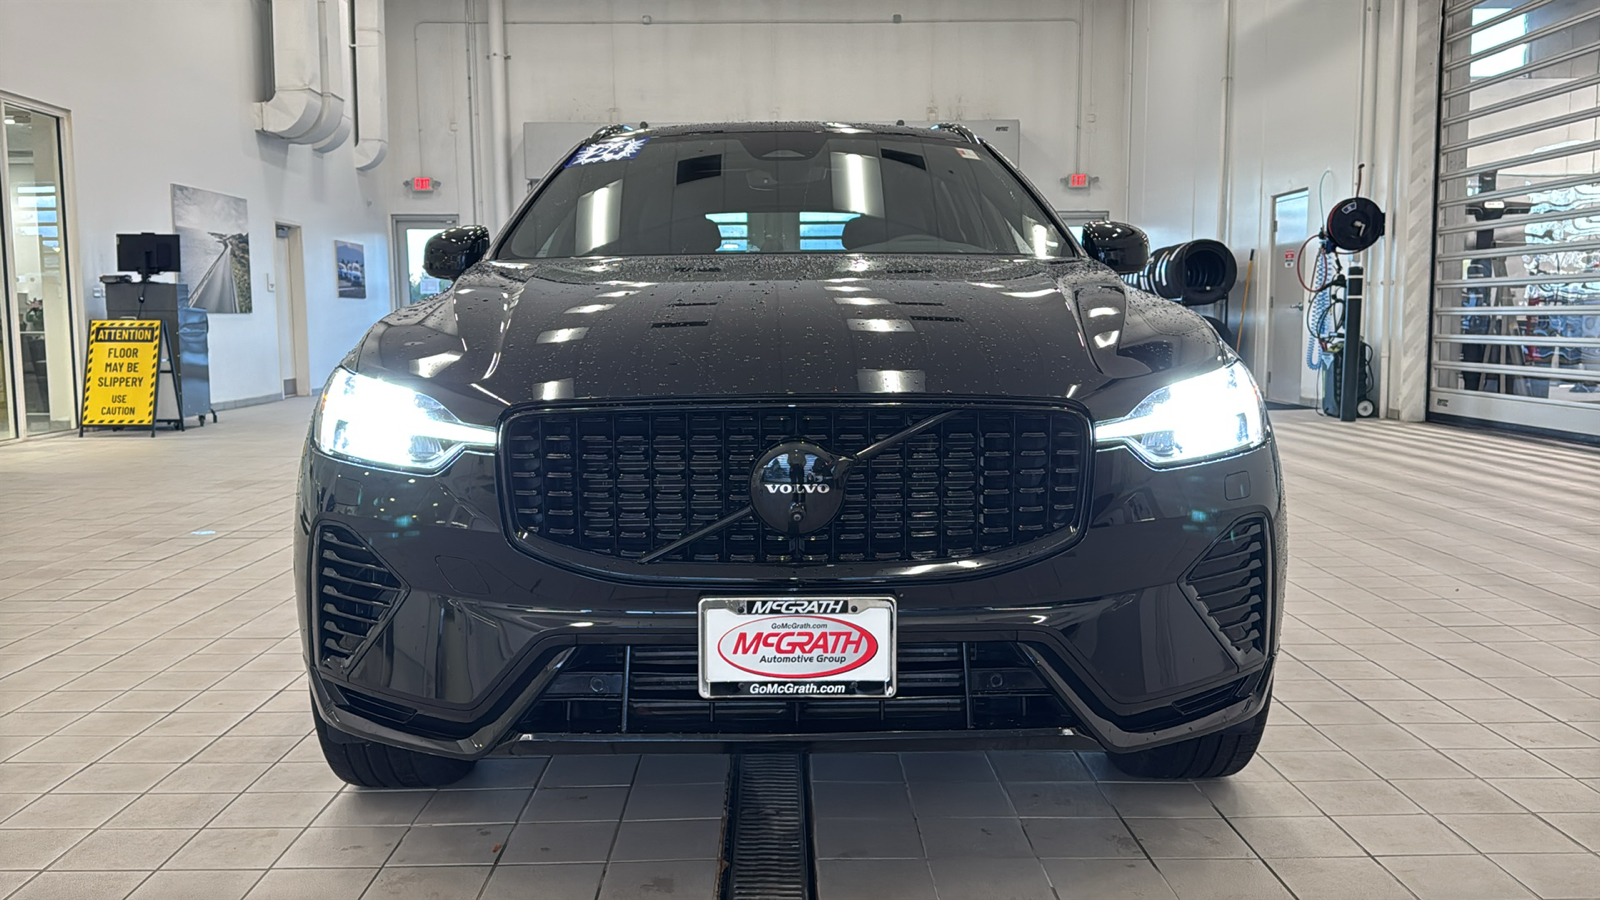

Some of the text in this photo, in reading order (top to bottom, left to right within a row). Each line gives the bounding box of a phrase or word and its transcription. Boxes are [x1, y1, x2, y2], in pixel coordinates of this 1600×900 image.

[414, 178, 430, 190] EXIT
[1071, 174, 1087, 186] EXIT
[97, 329, 152, 341] ATTENTION
[107, 348, 139, 358] FLOOR
[104, 362, 139, 373] MAY BE
[97, 376, 144, 388] SLIPPERY
[111, 395, 127, 403] USE
[100, 407, 136, 416] CAUTION
[764, 483, 830, 494] VOLVO
[771, 622, 828, 630] GoMcGrath.com
[759, 655, 847, 664] Automotive Group
[749, 683, 846, 694] GoMcGrath.com
